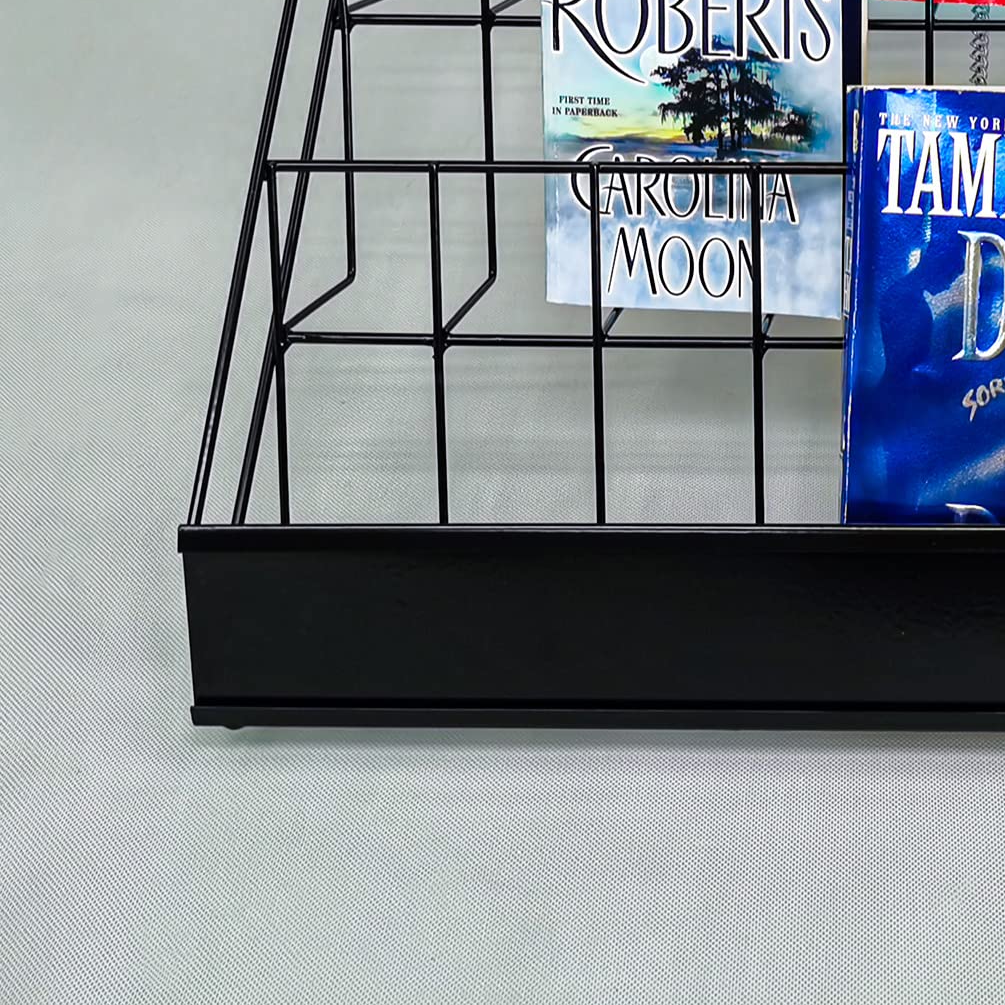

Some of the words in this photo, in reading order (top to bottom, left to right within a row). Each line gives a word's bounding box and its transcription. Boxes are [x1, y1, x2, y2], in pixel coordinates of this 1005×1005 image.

[559, 95, 585, 105] FIRST
[587, 96, 610, 105] TIME
[552, 106, 562, 115] IN
[564, 107, 618, 118] PAPERBACK
[879, 112, 911, 127] THE
[922, 114, 959, 129] NEW
